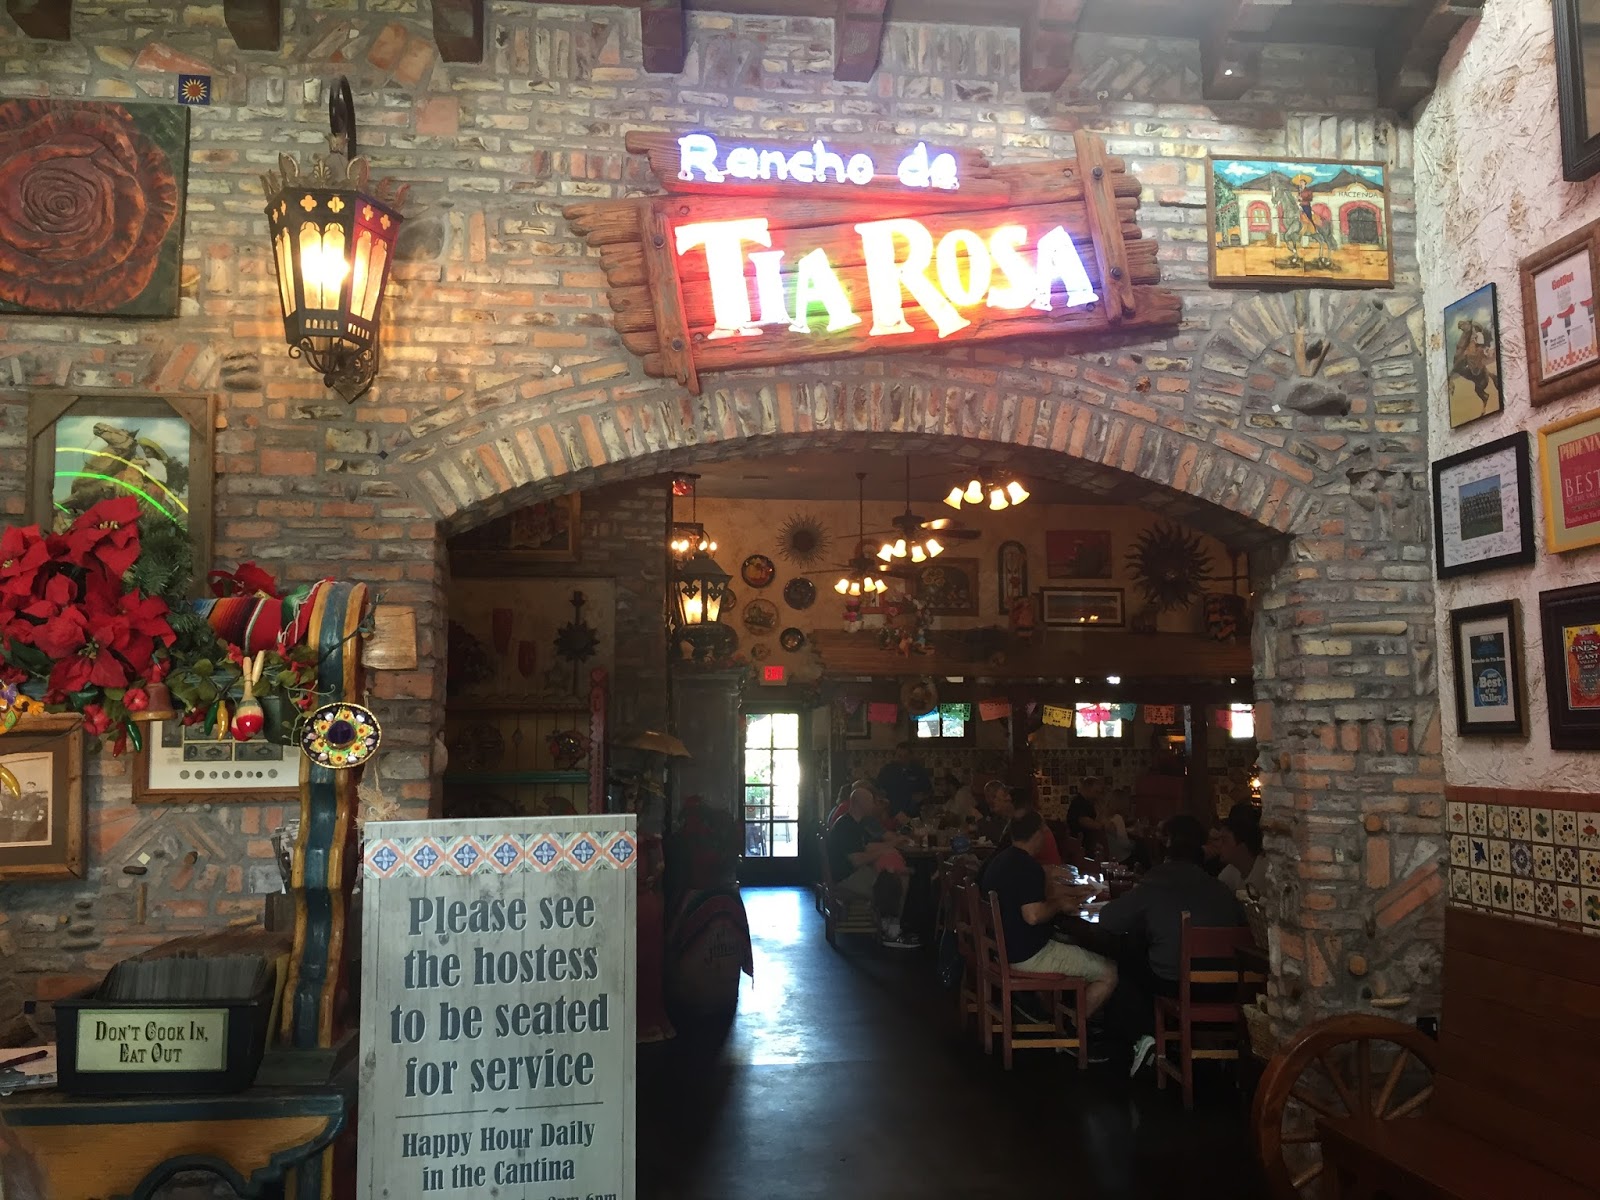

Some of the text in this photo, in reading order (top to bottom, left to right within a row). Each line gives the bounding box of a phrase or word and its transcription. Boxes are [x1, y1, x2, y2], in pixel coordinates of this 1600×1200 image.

[678, 134, 960, 190] Rancho de
[1338, 191, 1379, 199] HACIENDA
[675, 217, 1099, 339] TIA ROSA
[1479, 676, 1502, 688] Best
[1480, 693, 1502, 703] Valley
[408, 895, 595, 936] Please see
[404, 944, 598, 989] the hostess
[95, 1020, 141, 1042] DON'T
[145, 1020, 185, 1042] COOK
[390, 993, 609, 1044] to be seated
[119, 1042, 182, 1063] EAT OUT
[404, 1048, 594, 1097] for service
[401, 1120, 595, 1159] Happy Hour Daily
[422, 1157, 575, 1191] in the Cantina
